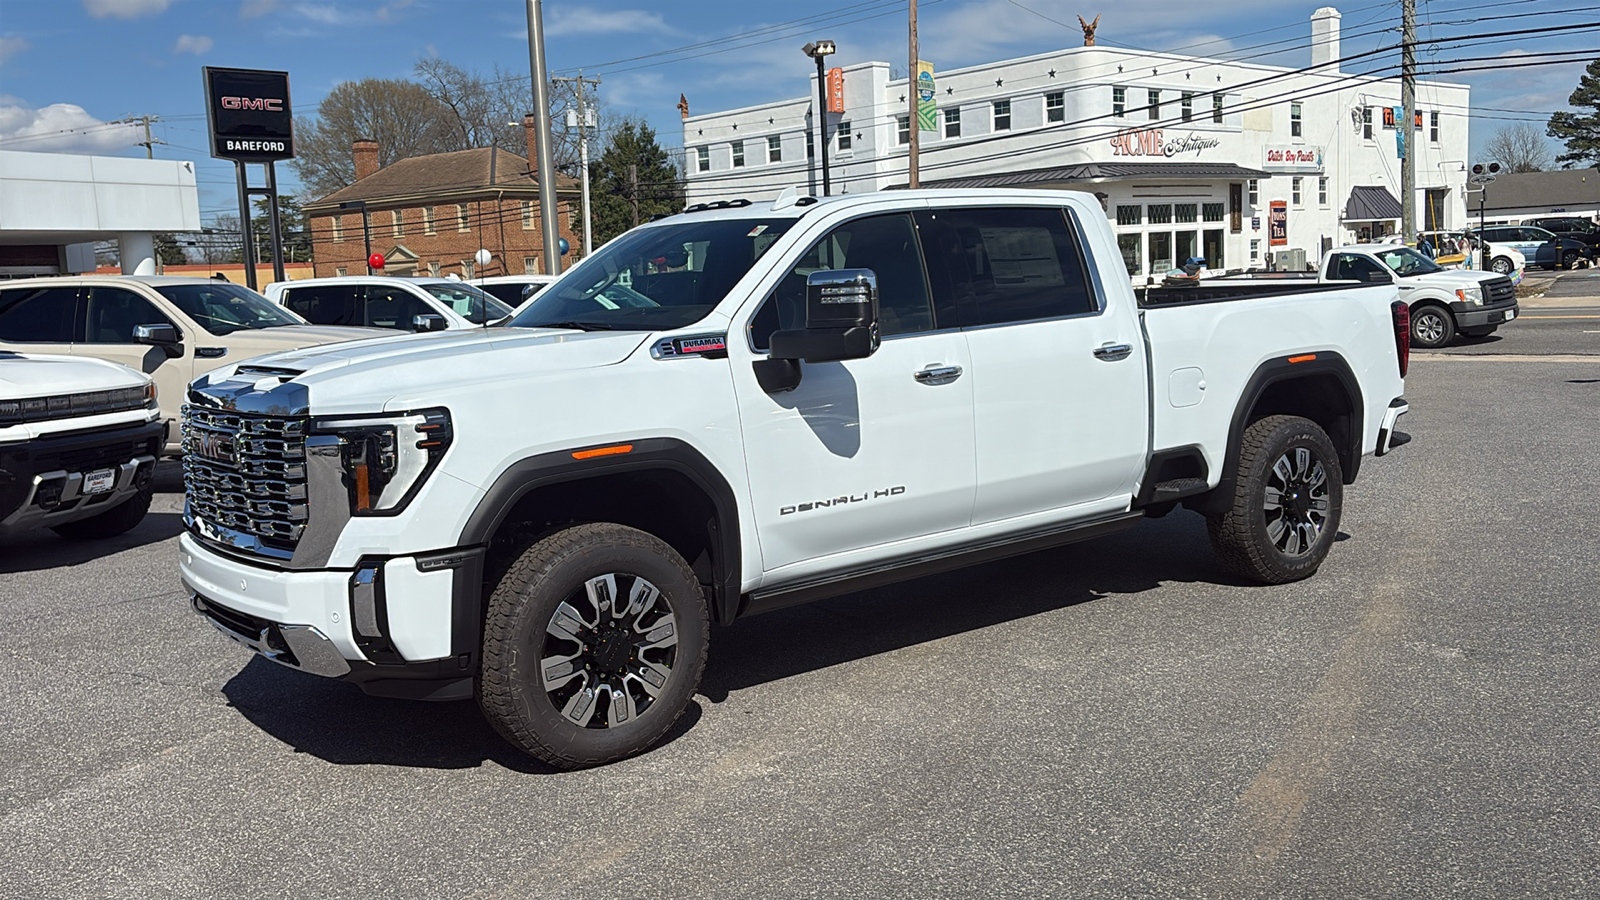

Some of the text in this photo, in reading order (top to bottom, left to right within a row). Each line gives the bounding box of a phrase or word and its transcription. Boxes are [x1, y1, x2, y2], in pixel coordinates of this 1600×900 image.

[221, 96, 284, 112] GMC
[226, 140, 285, 152] BAREFORD
[1110, 128, 1164, 157] ACME
[1267, 149, 1315, 164] Dutch Boy Paints
[1273, 226, 1285, 237] TEA
[683, 338, 722, 348] DURAMAX
[88, 472, 112, 482] BAREFORD
[779, 485, 906, 516] DENALI HD
